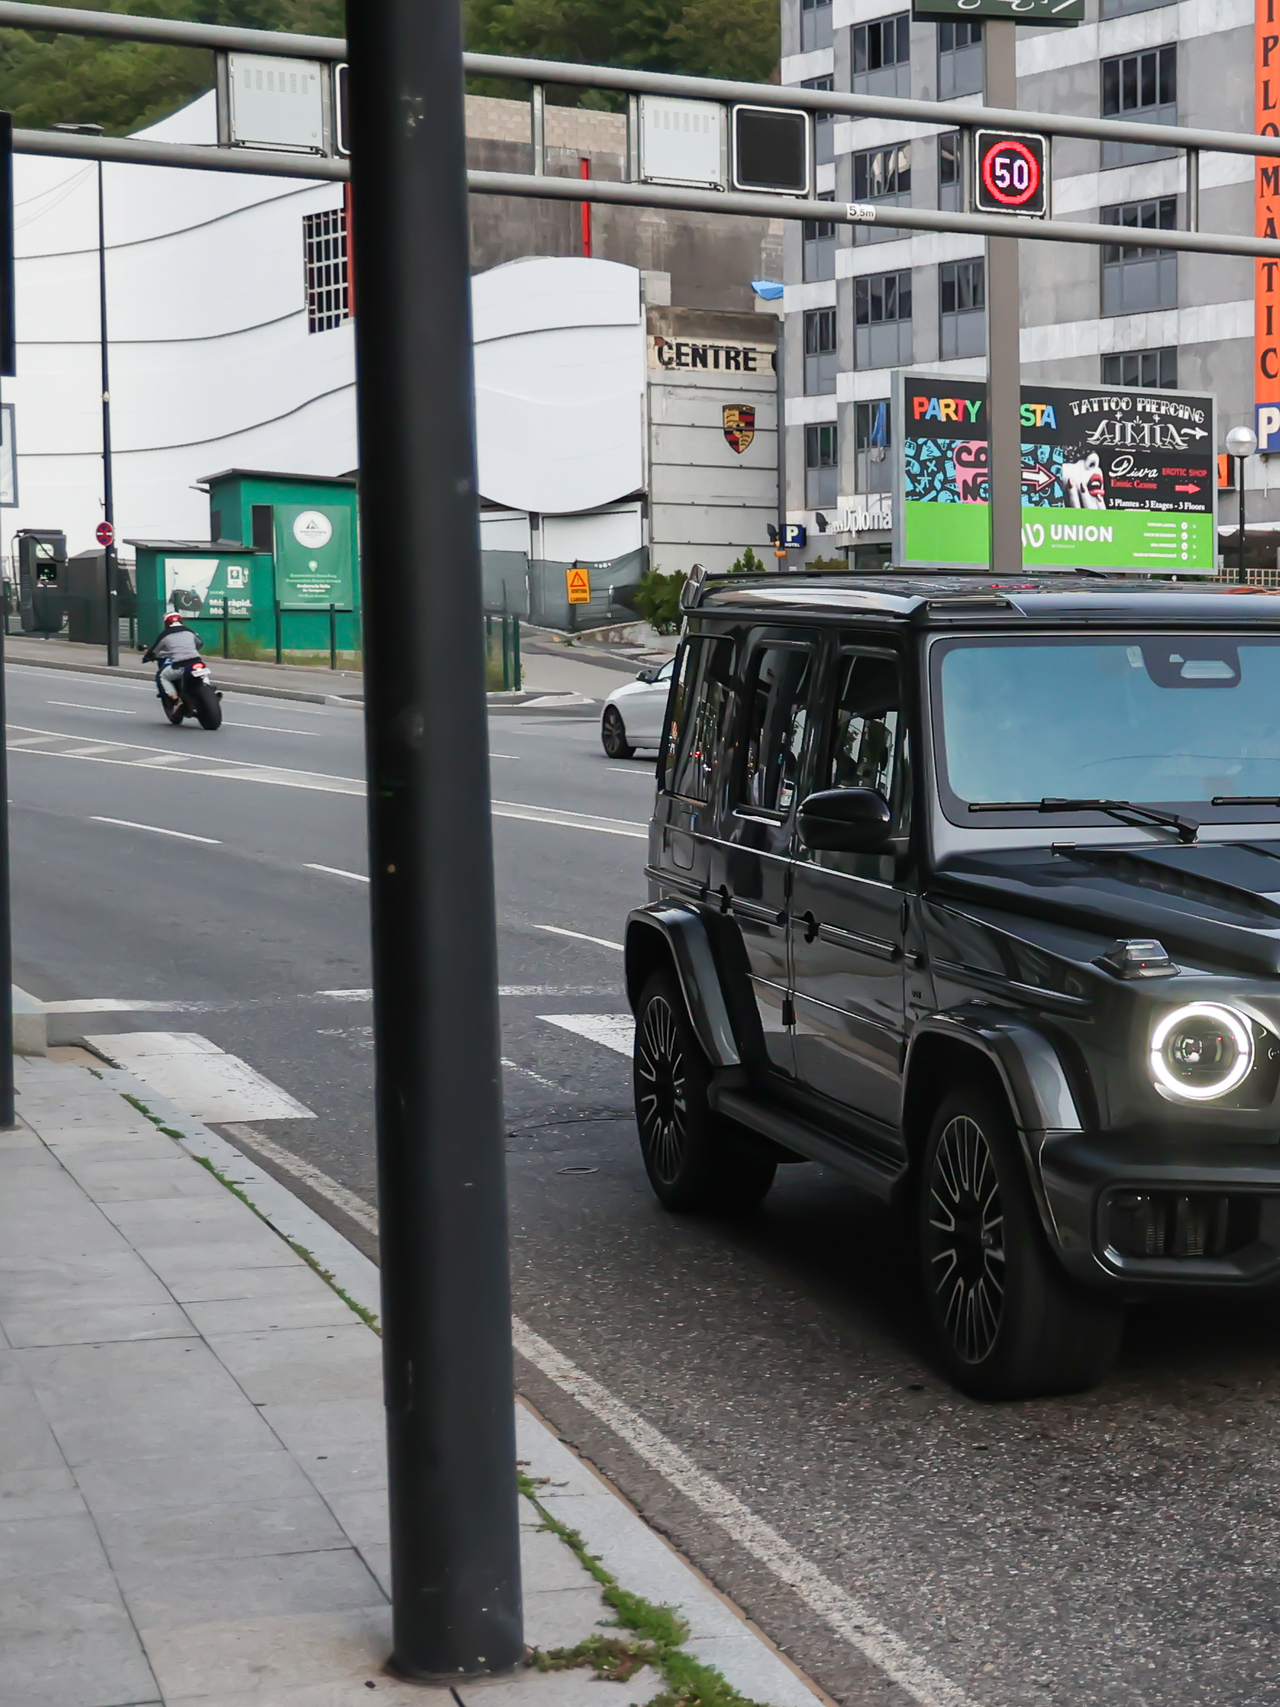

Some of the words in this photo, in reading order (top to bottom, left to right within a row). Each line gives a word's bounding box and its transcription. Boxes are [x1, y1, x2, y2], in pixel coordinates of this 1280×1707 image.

[994, 157, 1029, 190] 50
[657, 341, 757, 371] CENTRE
[913, 396, 982, 423] PARTY
[1069, 397, 1132, 416] TATTOO
[1137, 398, 1205, 424] PIERCING
[1258, 406, 1280, 449] P
[1108, 455, 1159, 478] Diva
[1162, 467, 1187, 476] EROTIC
[1188, 468, 1208, 478] SHOP
[1108, 498, 1114, 507] 3
[1115, 499, 1140, 509] Plantes
[1144, 500, 1150, 509] 3
[1150, 500, 1174, 512] Etages
[1178, 501, 1184, 509] 3
[1184, 502, 1206, 511] Floors
[786, 525, 799, 542] P
[1051, 524, 1113, 542] UNION
